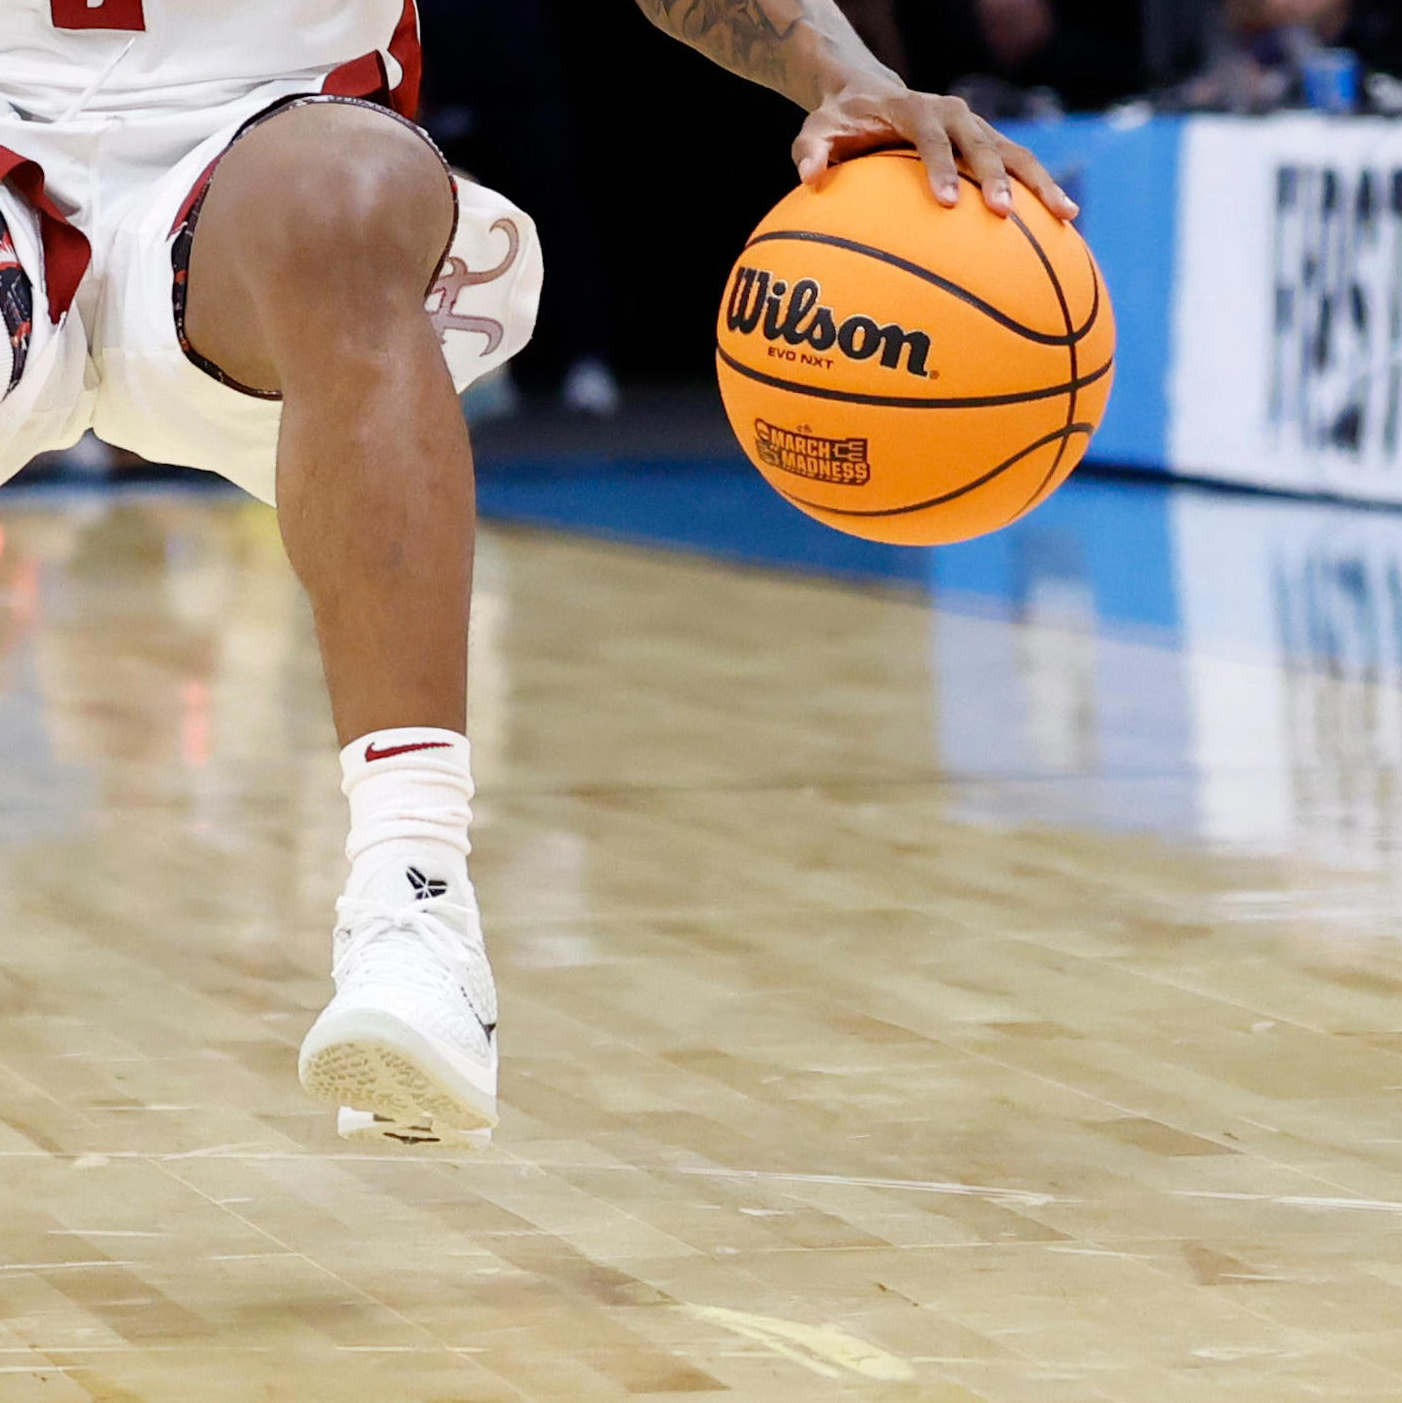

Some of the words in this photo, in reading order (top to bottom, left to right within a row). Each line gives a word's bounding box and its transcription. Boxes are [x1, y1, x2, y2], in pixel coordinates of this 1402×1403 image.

[727, 266, 931, 378] Wilson
[767, 345, 796, 362] EVO
[800, 351, 834, 370] NXT
[770, 428, 831, 459] MARCH
[781, 449, 868, 481] MADNESS
